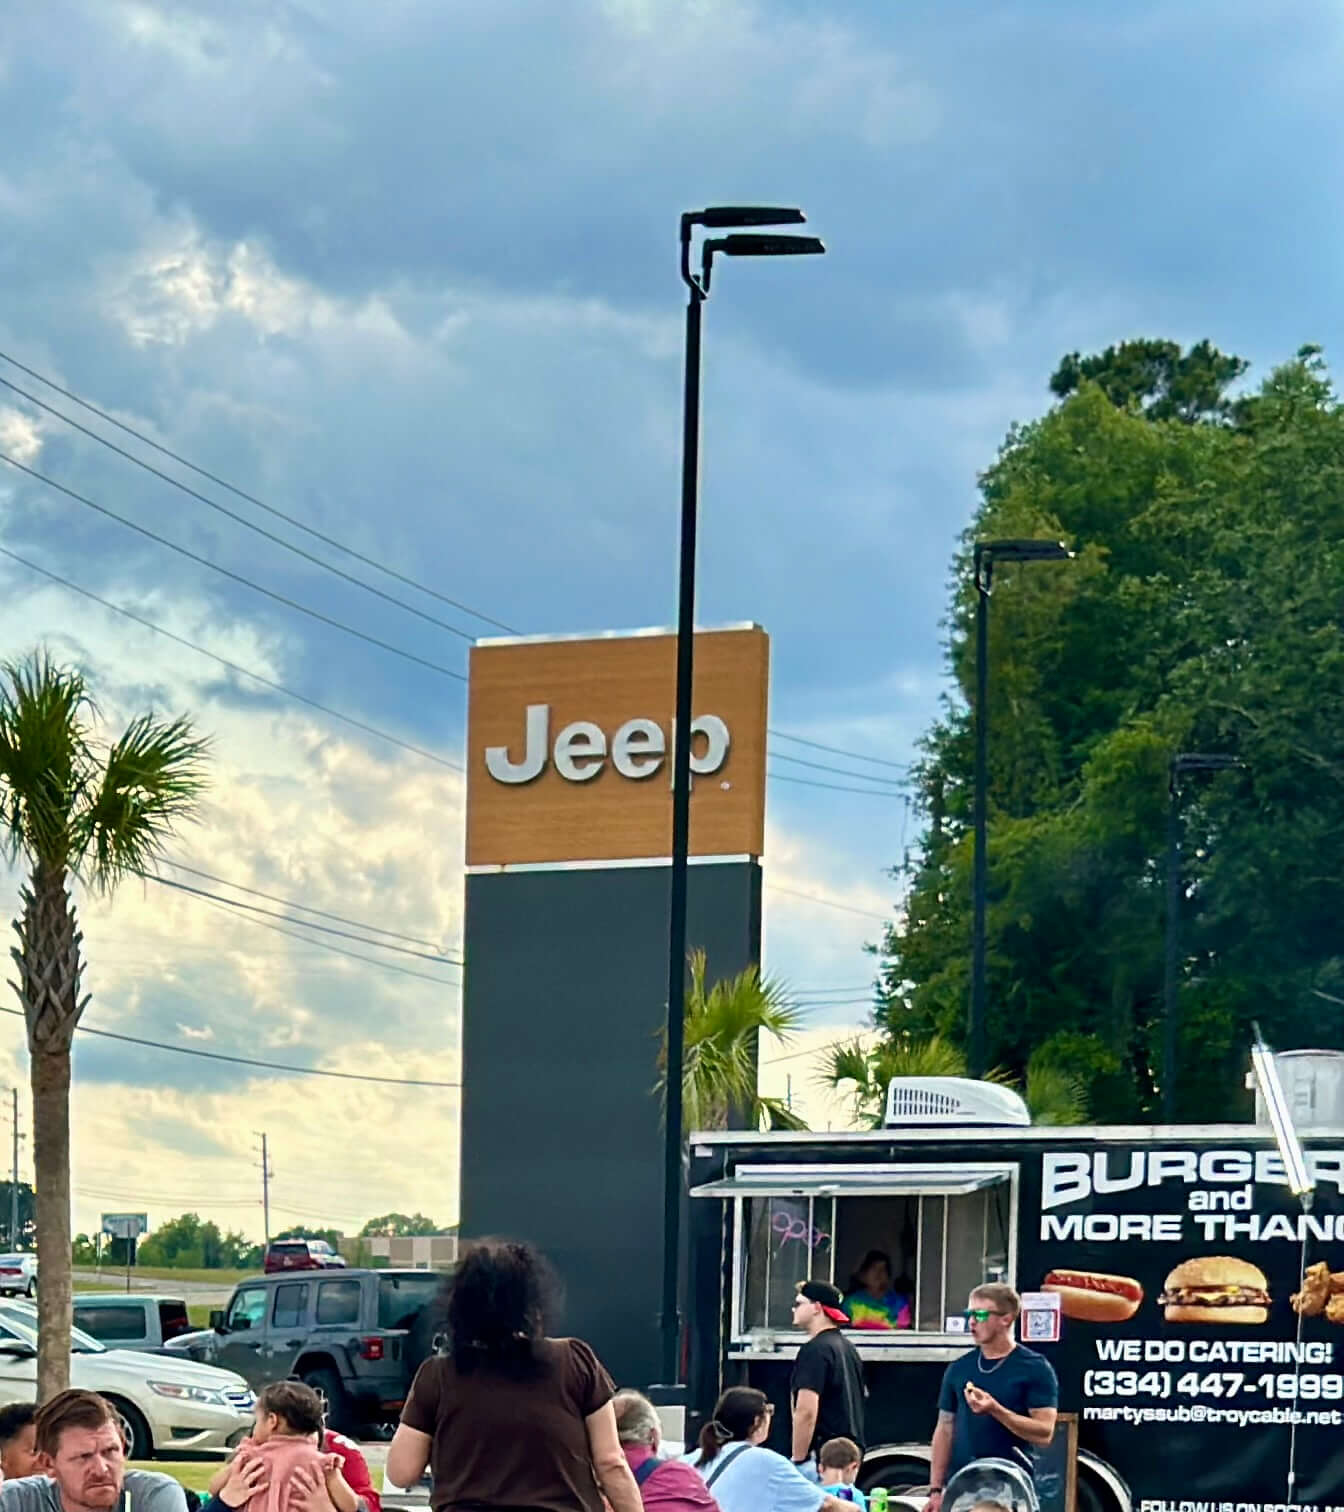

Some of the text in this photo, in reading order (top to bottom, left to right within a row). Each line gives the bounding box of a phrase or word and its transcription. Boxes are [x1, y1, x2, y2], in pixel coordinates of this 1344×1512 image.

[485, 704, 730, 791] Jeep
[1188, 1184, 1252, 1210] and
[1040, 1215, 1344, 1241] MORE THAN
[1095, 1339, 1333, 1364] WE DO CATERING!
[1083, 1369, 1344, 1400] (334) 447-1999
[1083, 1405, 1342, 1427] martyssub@troycable.net
